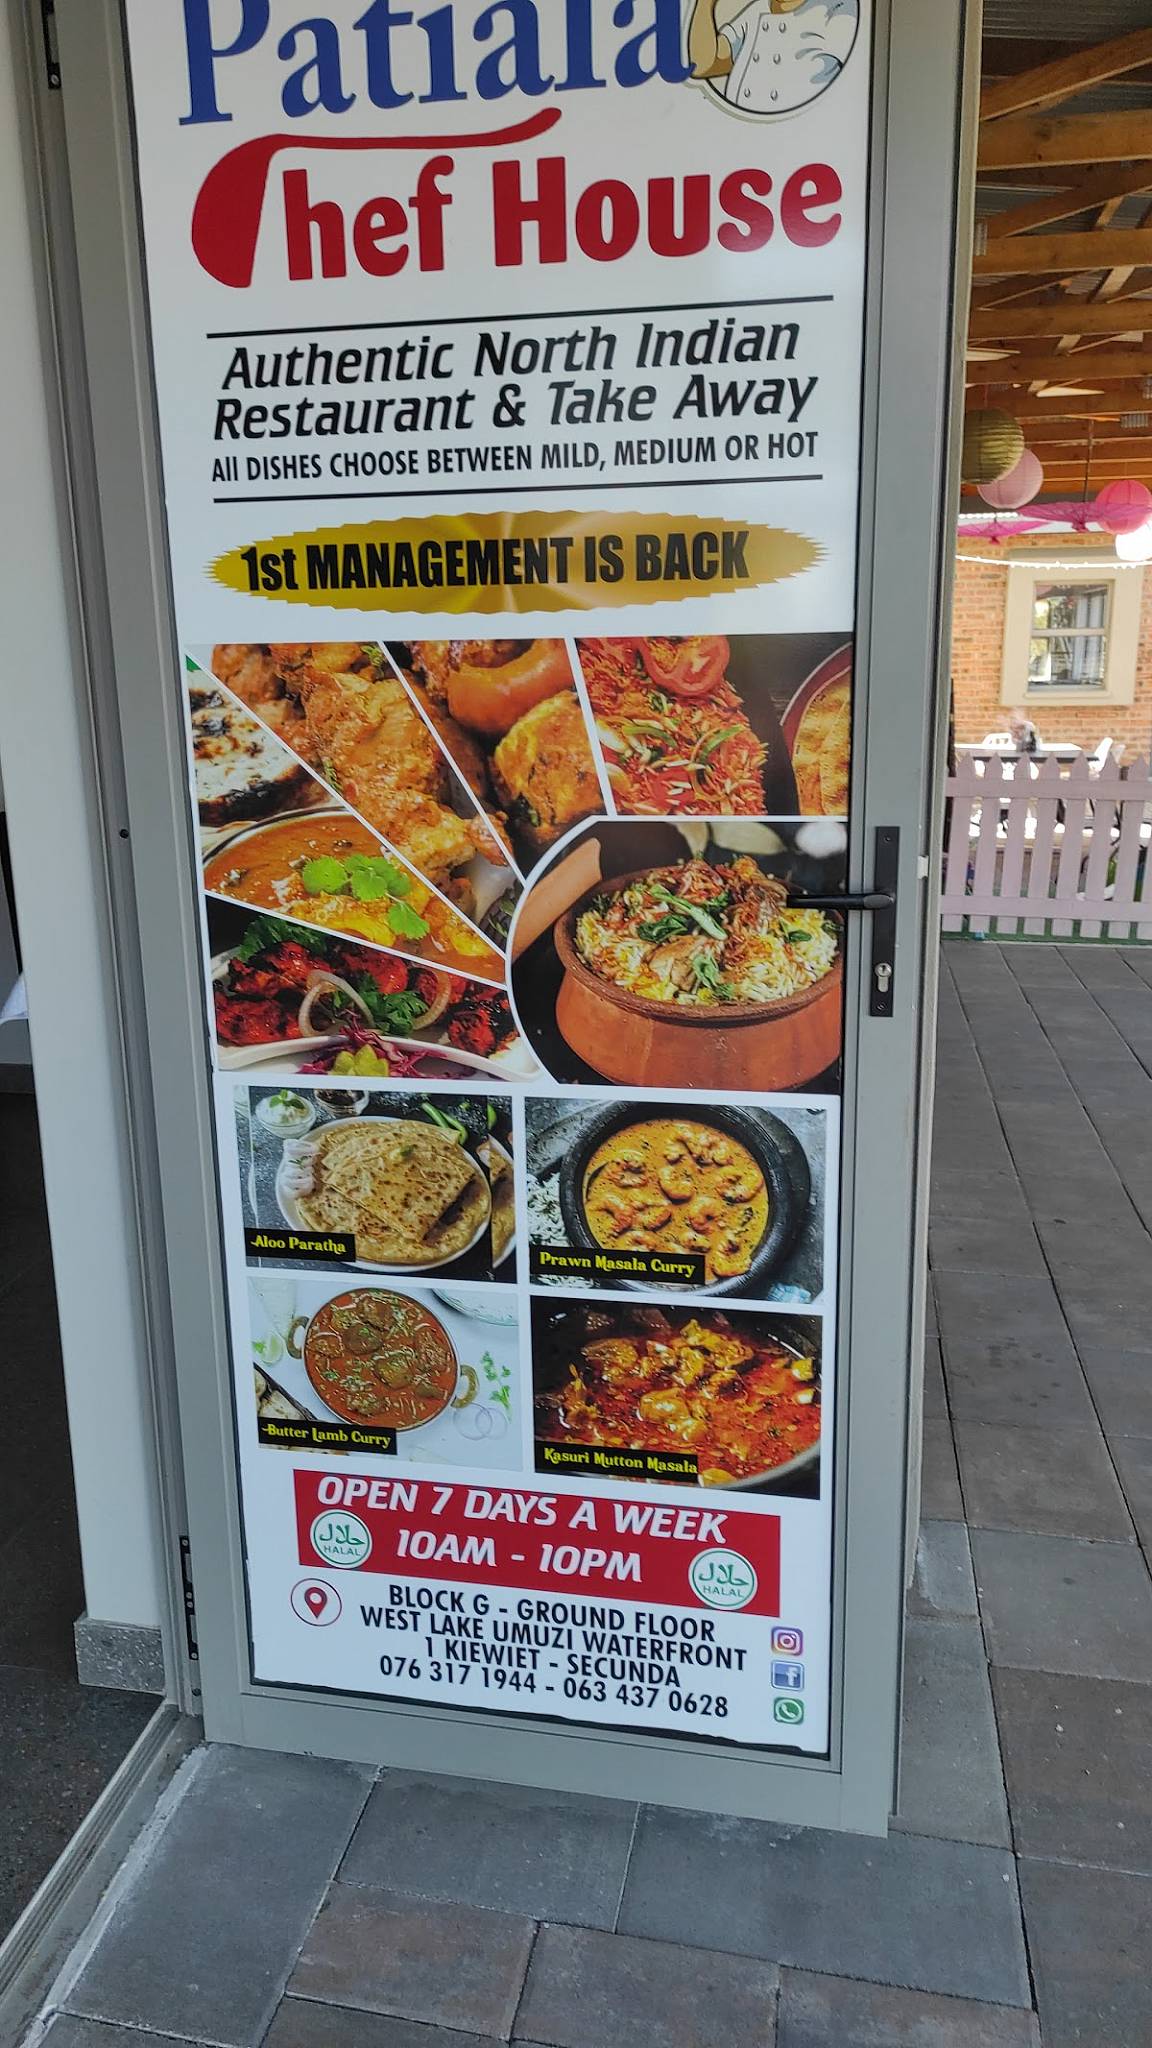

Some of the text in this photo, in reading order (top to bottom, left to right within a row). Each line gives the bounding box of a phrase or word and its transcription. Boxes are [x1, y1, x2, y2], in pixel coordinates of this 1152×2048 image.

[179, 0, 696, 125] Patiala
[491, 156, 843, 267] House
[221, 318, 801, 390] Authentic North Indian
[214, 374, 819, 440] Restaurant & Take Away
[247, 454, 322, 480] DISHES
[330, 450, 419, 478] CHOOSE
[428, 445, 532, 474] BETWEEN
[541, 441, 606, 471] MILD,
[614, 436, 716, 466] MEDIUM
[725, 434, 759, 461] OR
[768, 431, 818, 459] HOT
[240, 530, 750, 591] 1st MANAGEMENT IS BACK
[251, 1234, 347, 1255] Aloo Paratha
[539, 1252, 696, 1278] Prawn Masala Curry
[262, 1423, 392, 1449] Butter Lamb Curry
[544, 1447, 698, 1474] Kasuri Mutton Masala
[316, 1476, 728, 1544] OPEN 7 DAYS A WEEK
[323, 1545, 361, 1556] HALAL
[396, 1529, 498, 1567] 10AM
[539, 1543, 643, 1582] 10PM
[389, 1584, 465, 1613] BLOCK
[473, 1594, 490, 1616] G
[517, 1598, 625, 1631] GROUND
[635, 1612, 715, 1642] FLOOR
[703, 1585, 745, 1598] HALAL
[360, 1605, 748, 1671] WEST LAKE UMUZI WATERFRONT
[425, 1636, 433, 1657] 1
[445, 1638, 540, 1670] KIEWIET
[567, 1653, 681, 1688] SECUNDA
[380, 1655, 421, 1680] 076
[429, 1661, 471, 1685] 317
[481, 1666, 537, 1693] 1944
[563, 1677, 607, 1702] 063
[616, 1684, 660, 1708] 437
[668, 1690, 729, 1718] 0628
